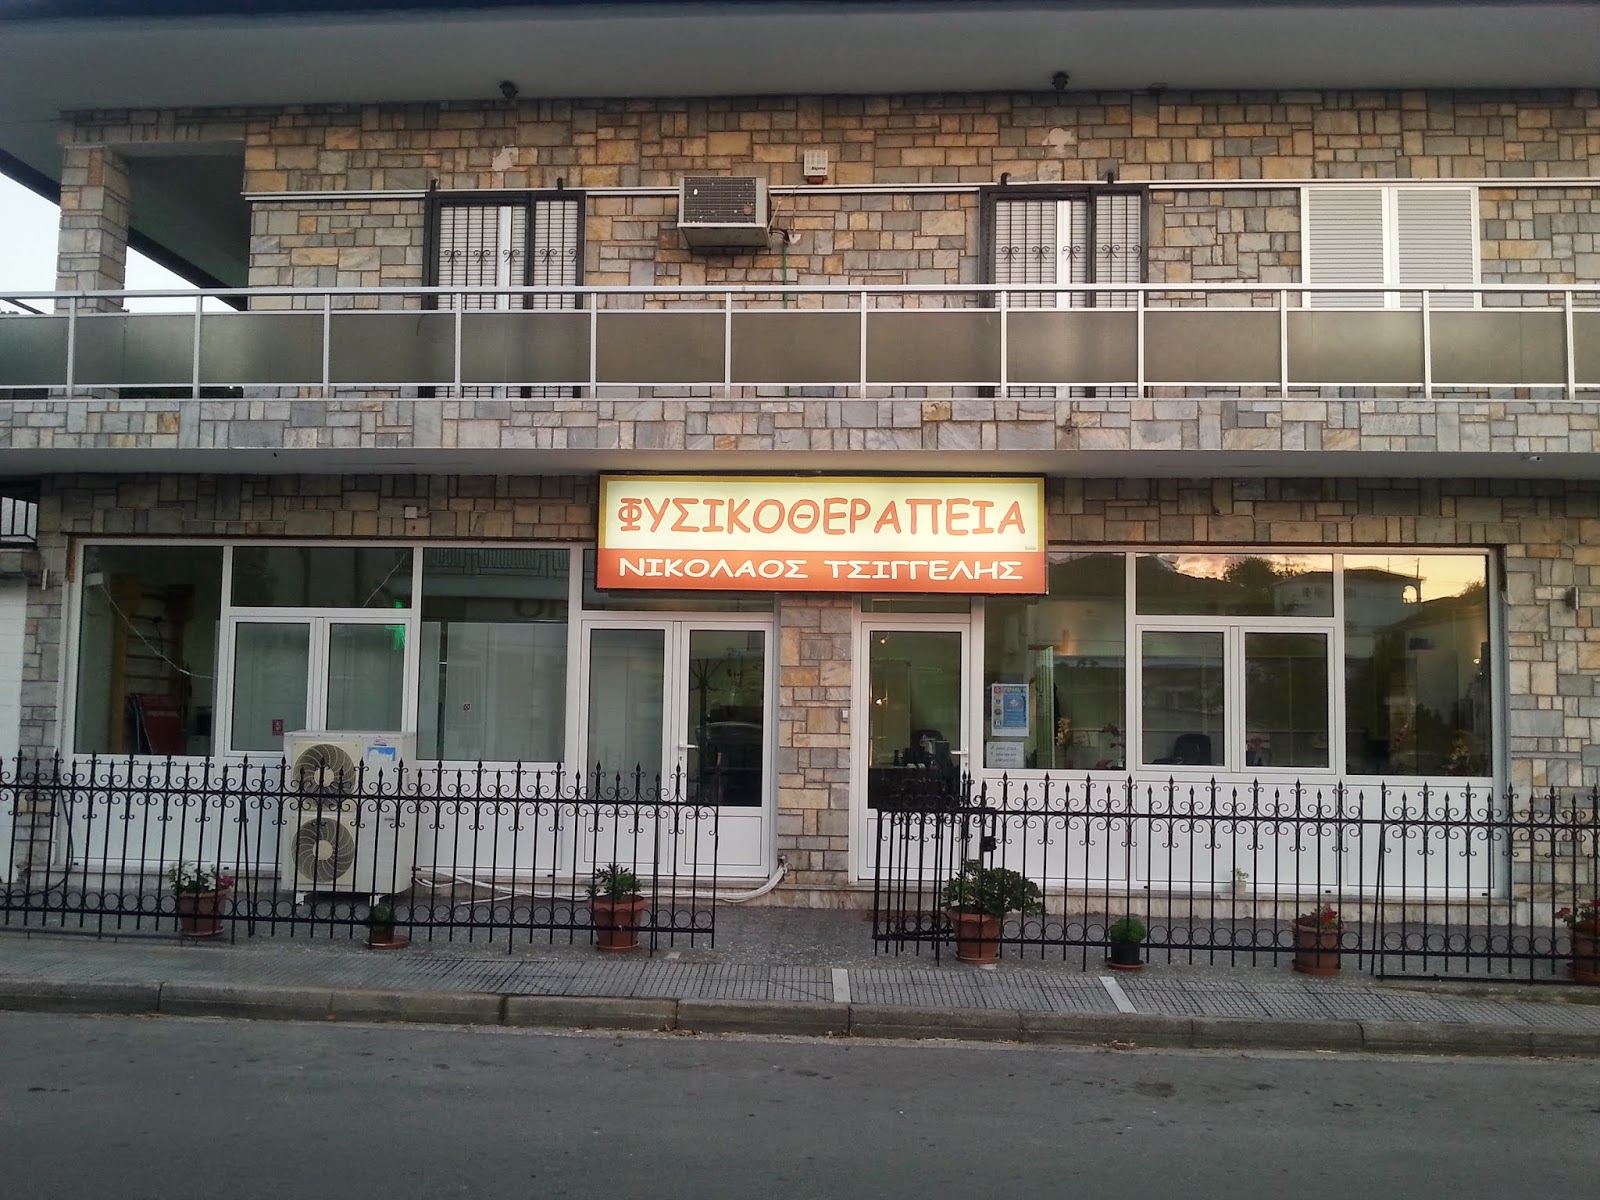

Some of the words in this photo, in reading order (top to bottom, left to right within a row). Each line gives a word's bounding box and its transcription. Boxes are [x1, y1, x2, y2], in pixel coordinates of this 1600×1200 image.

[617, 496, 1027, 536] ΦΥΣΙΚΟΘΕΡΑΠΕΙΑ
[618, 556, 809, 579] ΝΙΚΟΛΑΟΣ
[823, 558, 1024, 581] ΤΣΙΓΓΕΛΗΣ
